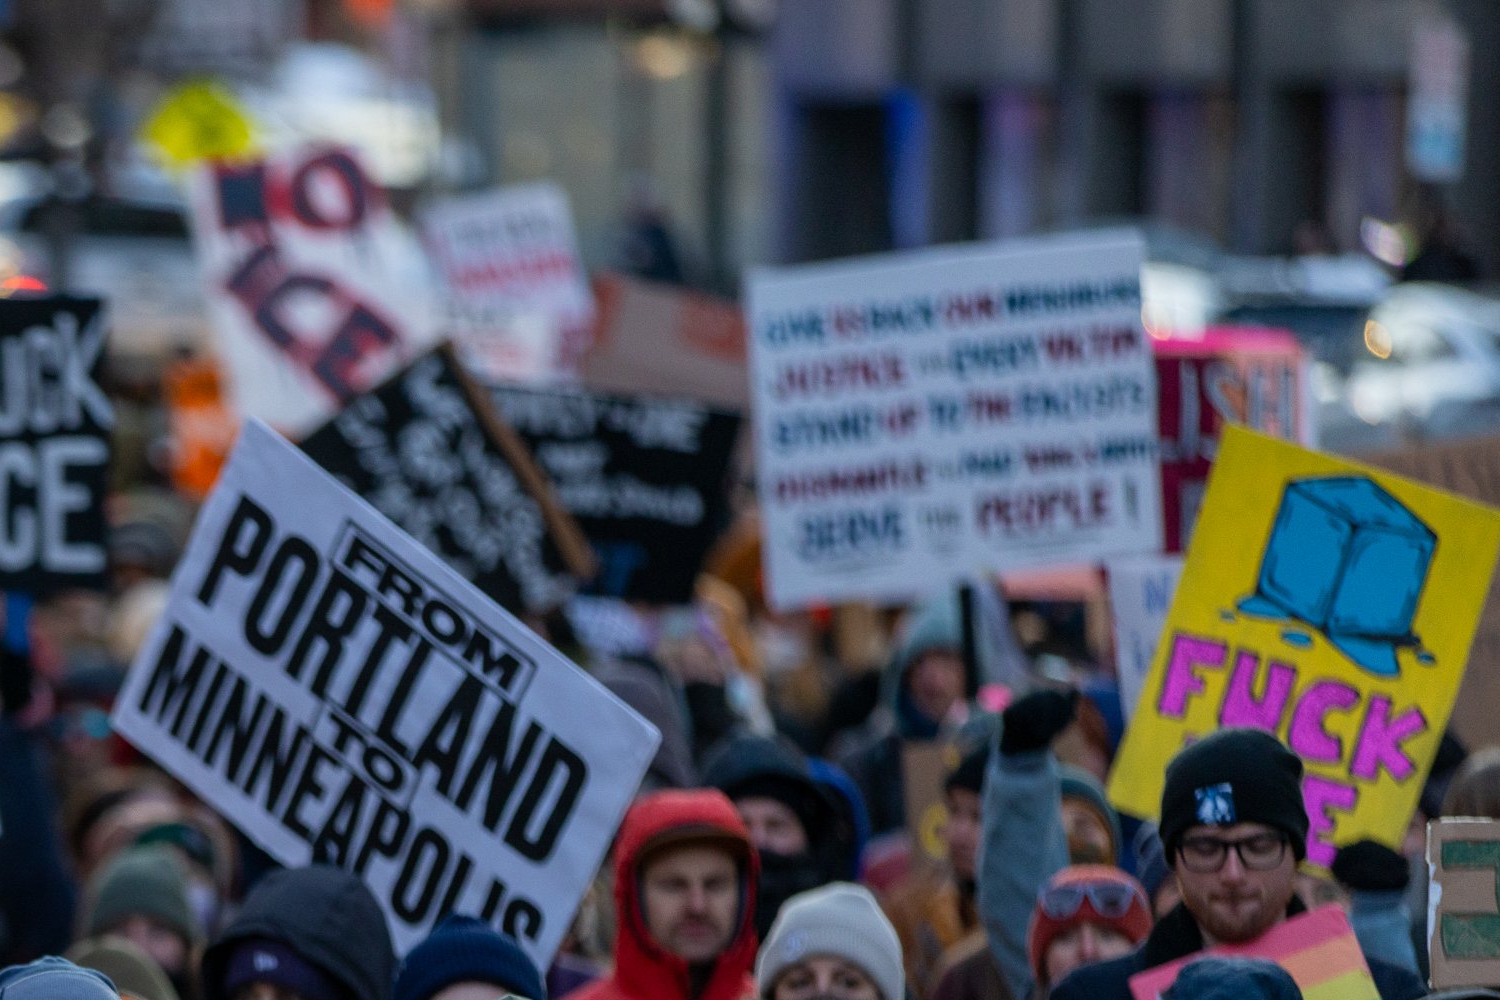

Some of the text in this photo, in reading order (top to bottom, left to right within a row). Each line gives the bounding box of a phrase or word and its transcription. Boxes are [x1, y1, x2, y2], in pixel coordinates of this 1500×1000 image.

[198, 494, 589, 866] PORTLAND
[341, 534, 523, 695] FROM
[322, 708, 407, 793] TO
[1157, 628, 1430, 783] FUCK
